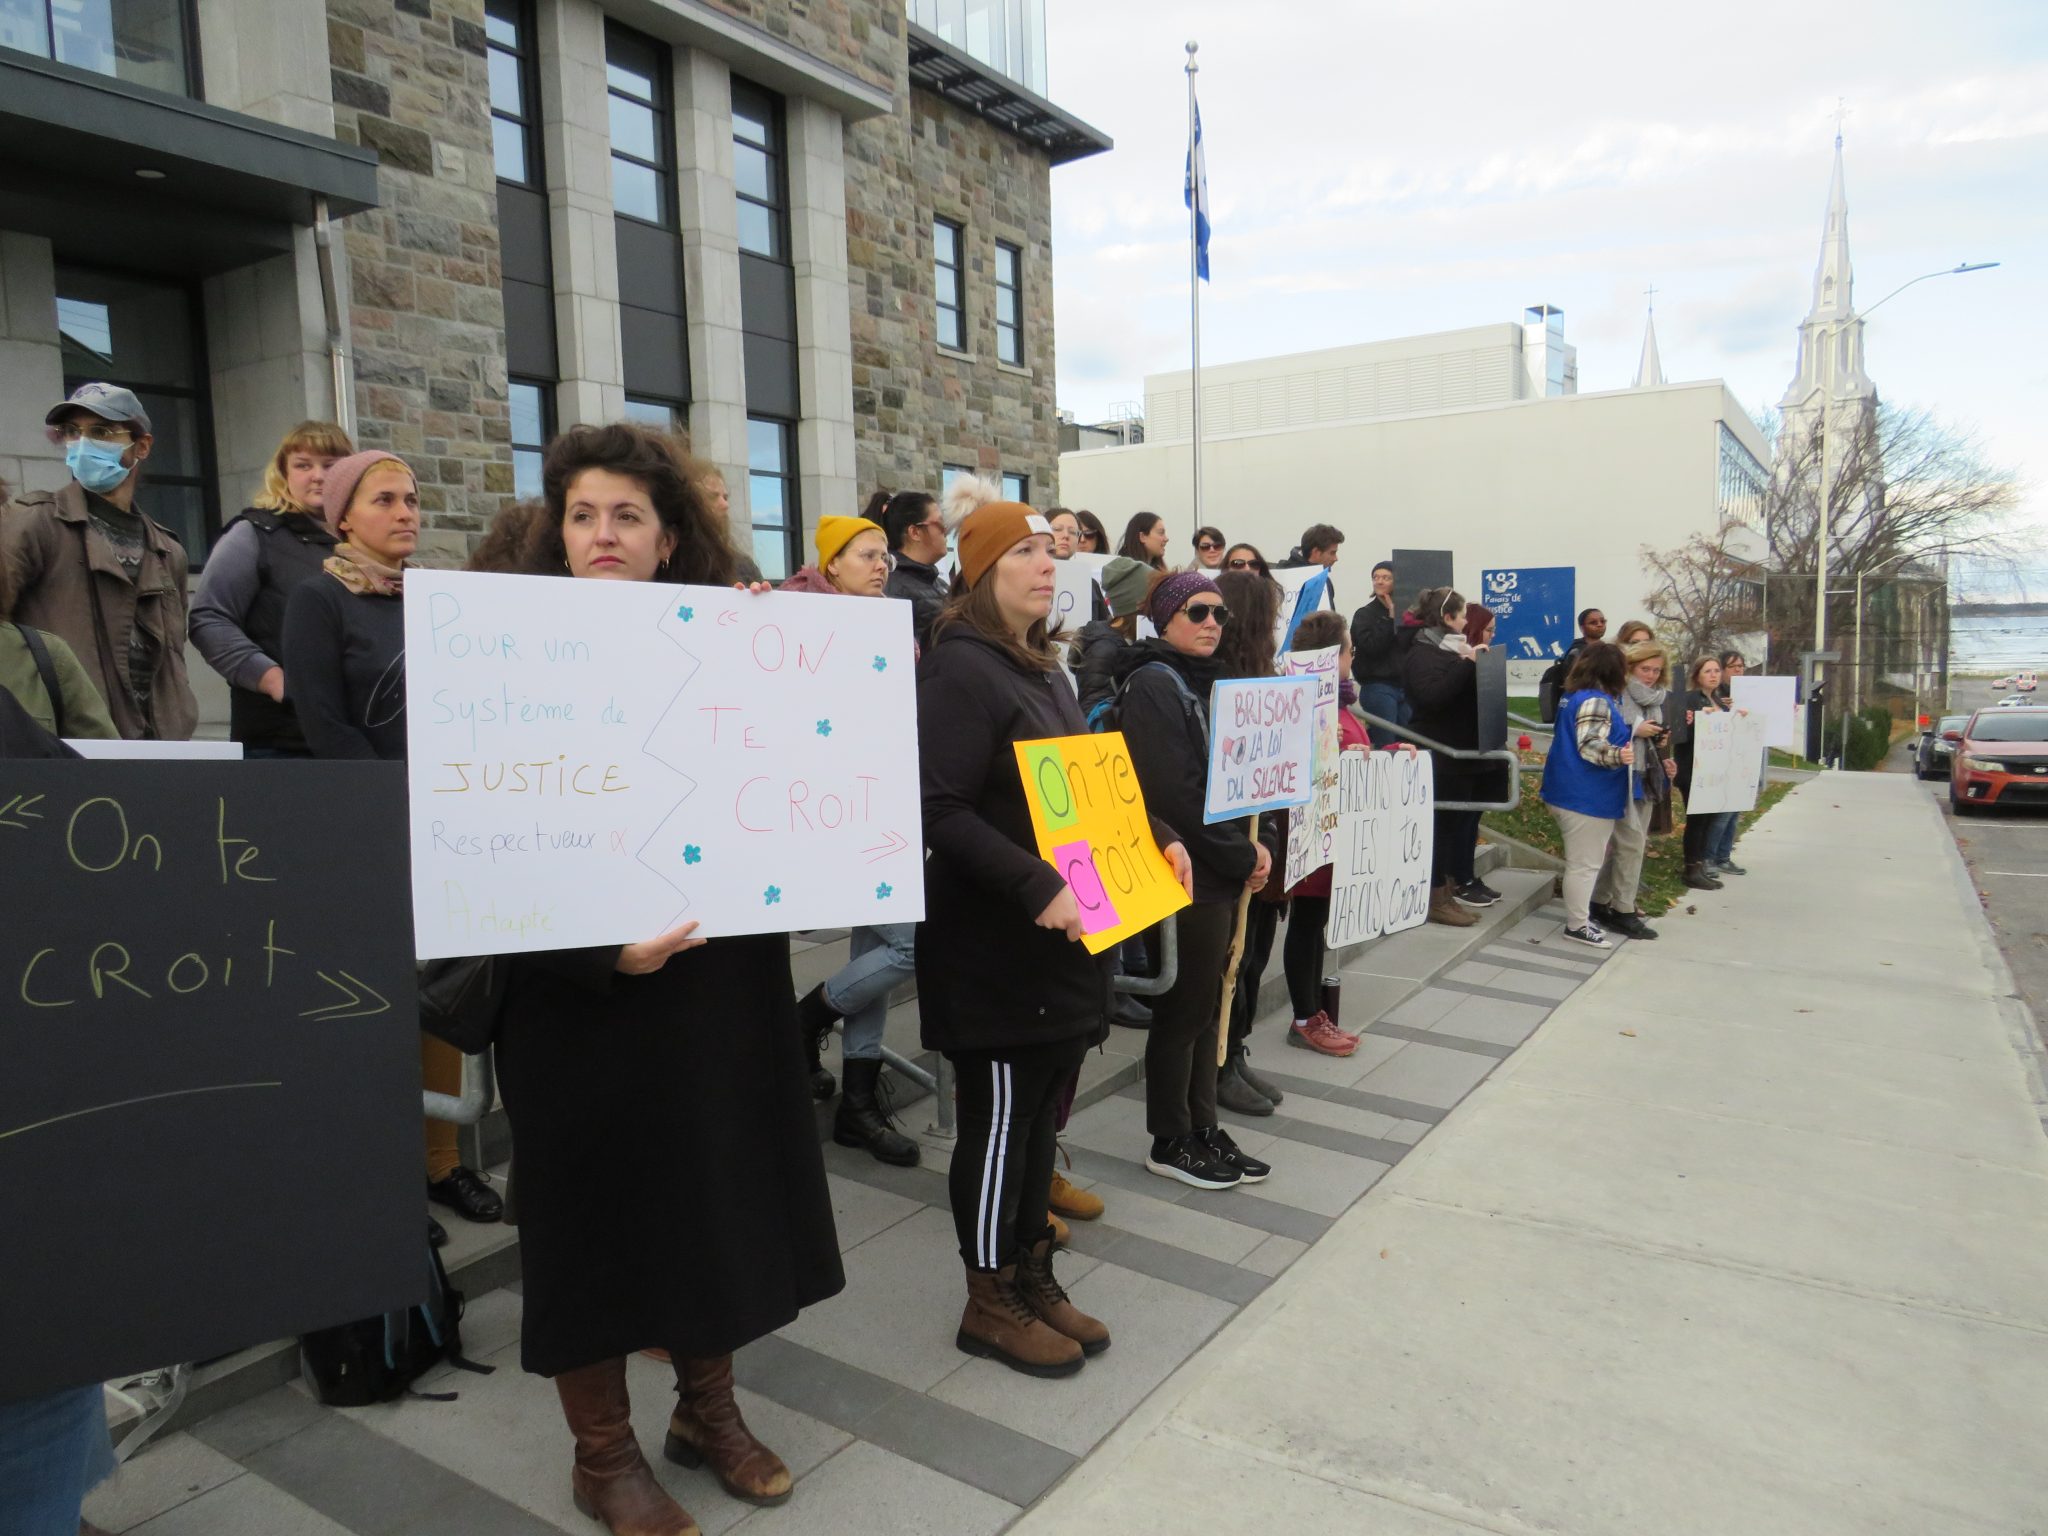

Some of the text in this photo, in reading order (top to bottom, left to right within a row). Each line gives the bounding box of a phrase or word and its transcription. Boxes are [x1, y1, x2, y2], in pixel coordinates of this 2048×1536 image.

[1511, 593, 1522, 602] de
[752, 624, 835, 674] ON
[433, 682, 627, 752] Système de
[698, 705, 766, 749] TE
[1249, 731, 1264, 762] LA
[1038, 742, 1137, 818] On te
[1227, 775, 1244, 802] DU
[1339, 756, 1392, 815] BRISONS
[67, 797, 162, 871] On
[217, 796, 278, 884] te
[432, 819, 597, 863] Respectueux
[1352, 817, 1378, 876] LES
[1400, 815, 1422, 864] te
[1332, 878, 1384, 944] TABOUS
